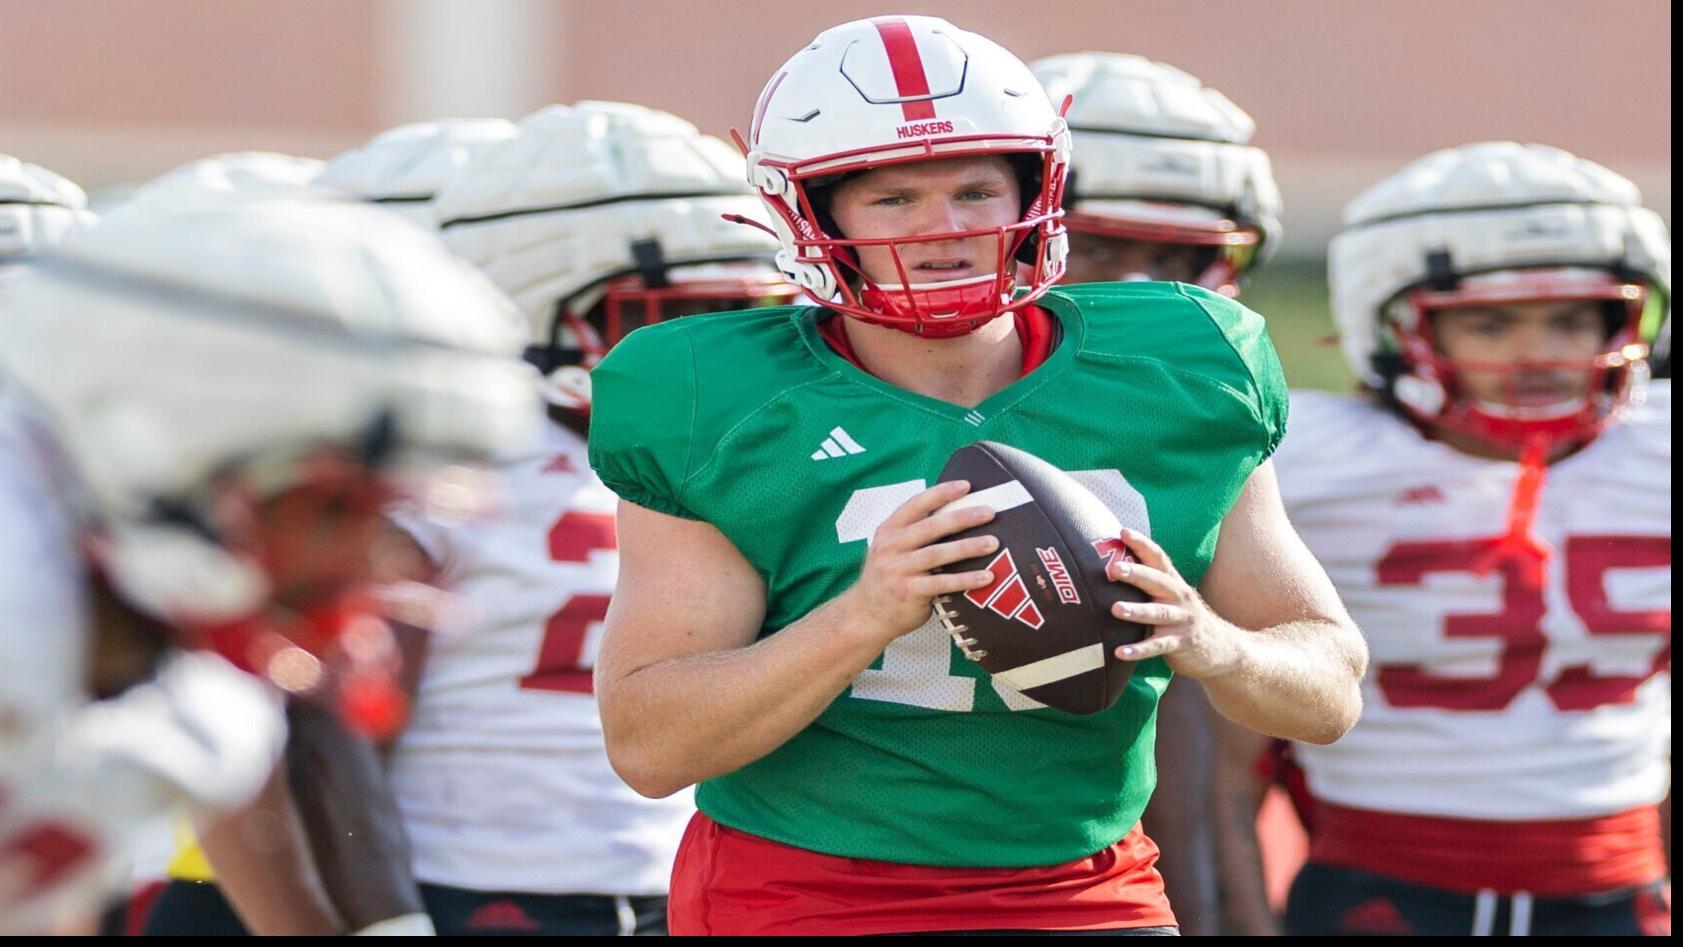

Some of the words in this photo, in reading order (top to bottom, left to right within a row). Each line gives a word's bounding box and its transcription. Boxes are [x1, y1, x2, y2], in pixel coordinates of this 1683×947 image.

[896, 120, 954, 139] HUSKERS
[1035, 546, 1081, 604] DIME
[1373, 534, 1671, 712] 35
